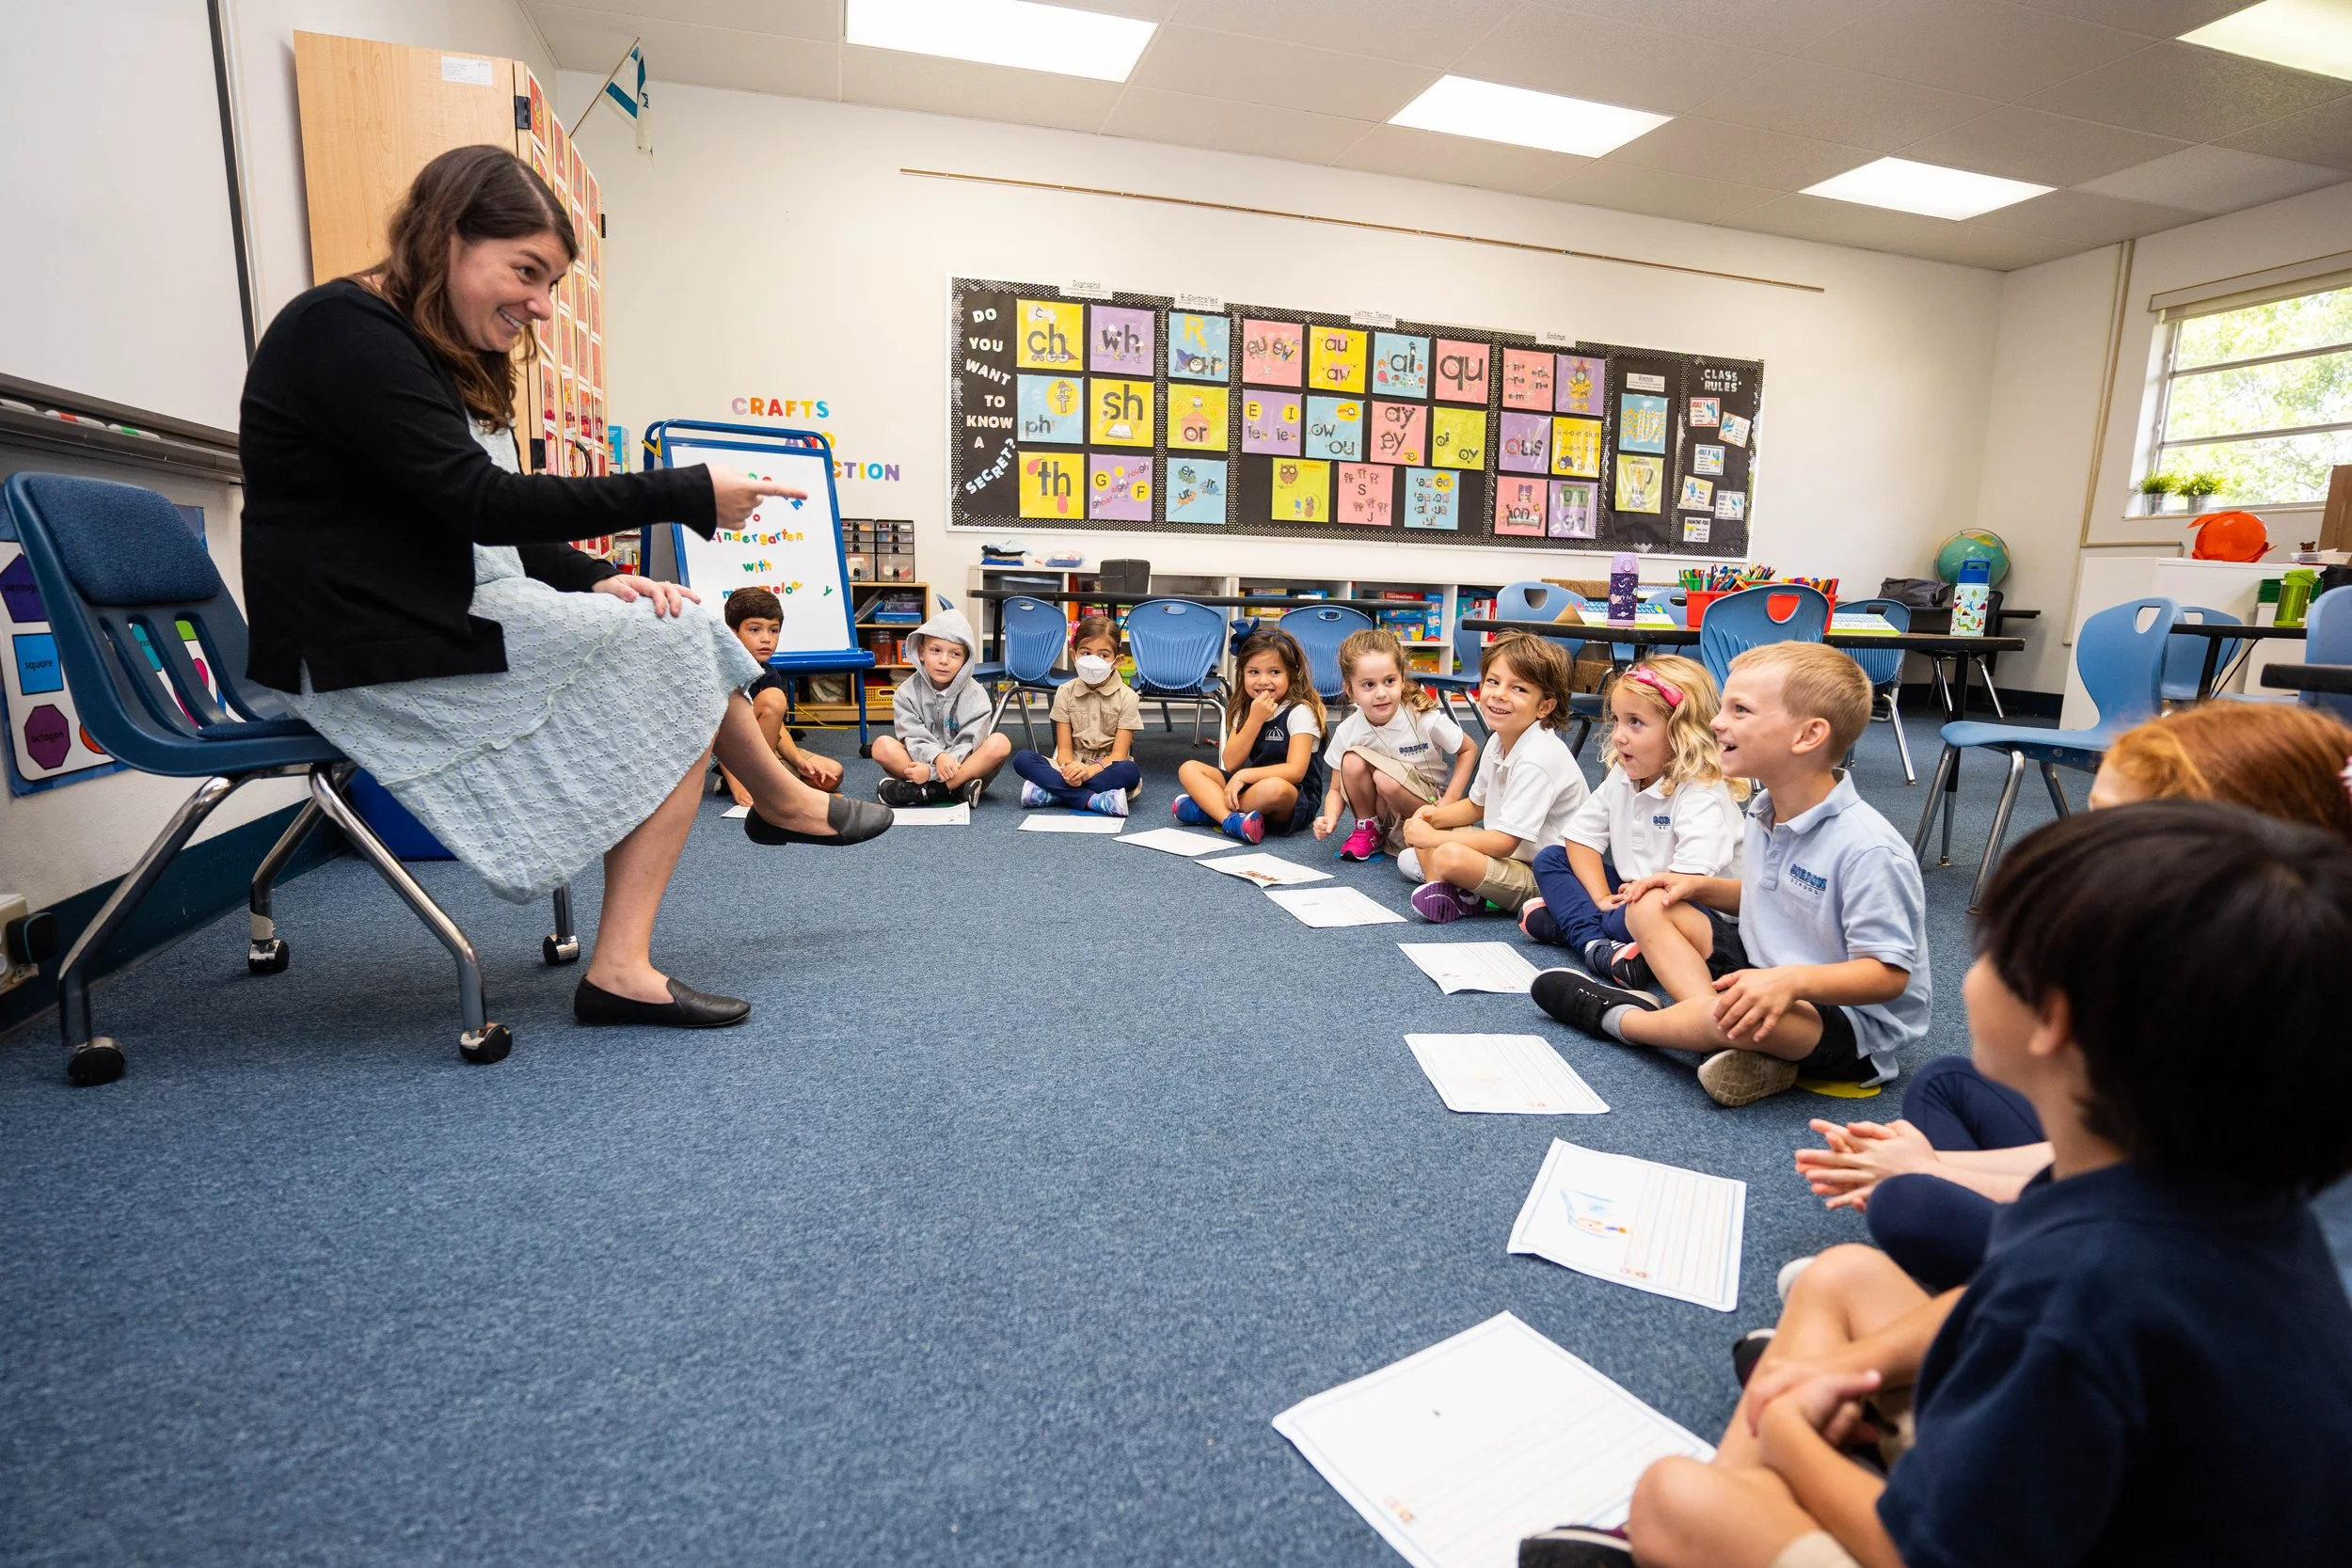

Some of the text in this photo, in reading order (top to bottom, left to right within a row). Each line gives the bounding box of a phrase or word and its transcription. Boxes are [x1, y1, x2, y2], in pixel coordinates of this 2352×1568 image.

[973, 308, 997, 323] DO
[969, 337, 1004, 352] YOU
[1027, 323, 1066, 356] ch
[1102, 324, 1140, 354] wh
[1325, 339, 1347, 353] au
[965, 358, 1011, 386] WANT
[1327, 369, 1350, 381] aw
[1439, 356, 1484, 391] qu
[1704, 369, 1738, 382] CLASS
[1704, 380, 1738, 392] RULES
[732, 398, 830, 419] CRAFTS
[984, 395, 1006, 408] TO
[1103, 384, 1143, 421] sh
[1248, 404, 1258, 417] E
[966, 415, 1013, 429] KNOW
[1025, 415, 1052, 438] ph
[974, 436, 985, 448] A
[1184, 427, 1208, 443] or
[833, 460, 900, 482] CTION
[965, 437, 1016, 495] SECRET?
[1038, 461, 1071, 497] th
[1095, 474, 1107, 487] G
[1136, 486, 1145, 499] F
[1358, 483, 1366, 496] S
[1564, 490, 1586, 503] D T
[712, 529, 803, 546] indergarten
[742, 559, 771, 574] with
[24, 659, 54, 672] square
[31, 731, 65, 744] octagon
[1790, 863, 1827, 890] GORDON
